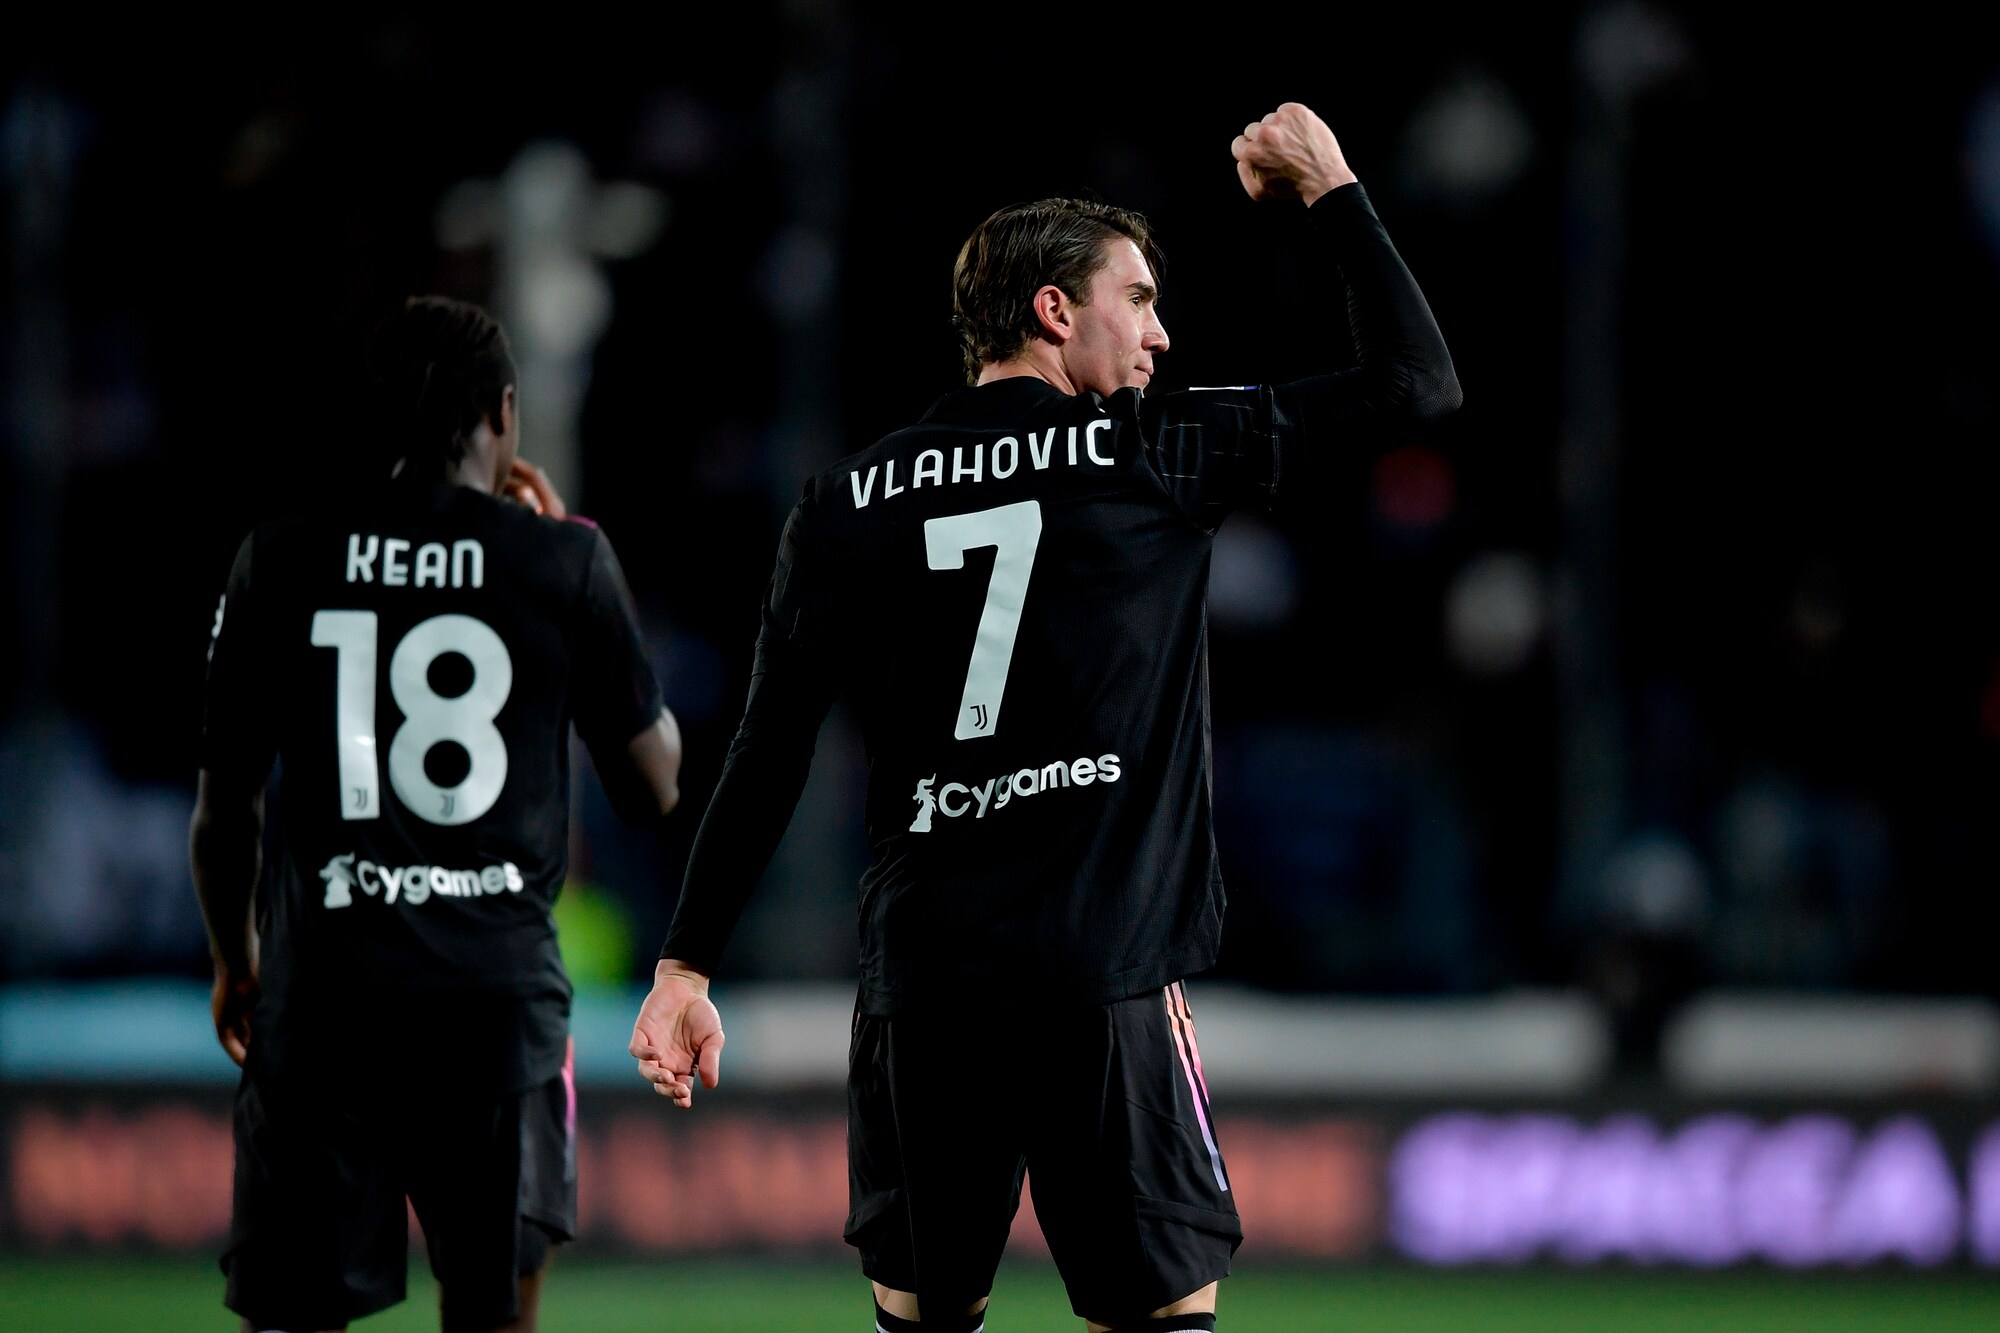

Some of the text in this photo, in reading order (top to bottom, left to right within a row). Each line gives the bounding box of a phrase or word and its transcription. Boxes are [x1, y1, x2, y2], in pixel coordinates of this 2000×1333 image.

[346, 533, 484, 589] KEAN
[923, 499, 1043, 741] 7
[310, 609, 514, 826] 18
[938, 753, 1122, 819] Cygames
[356, 860, 525, 905] Cygames
